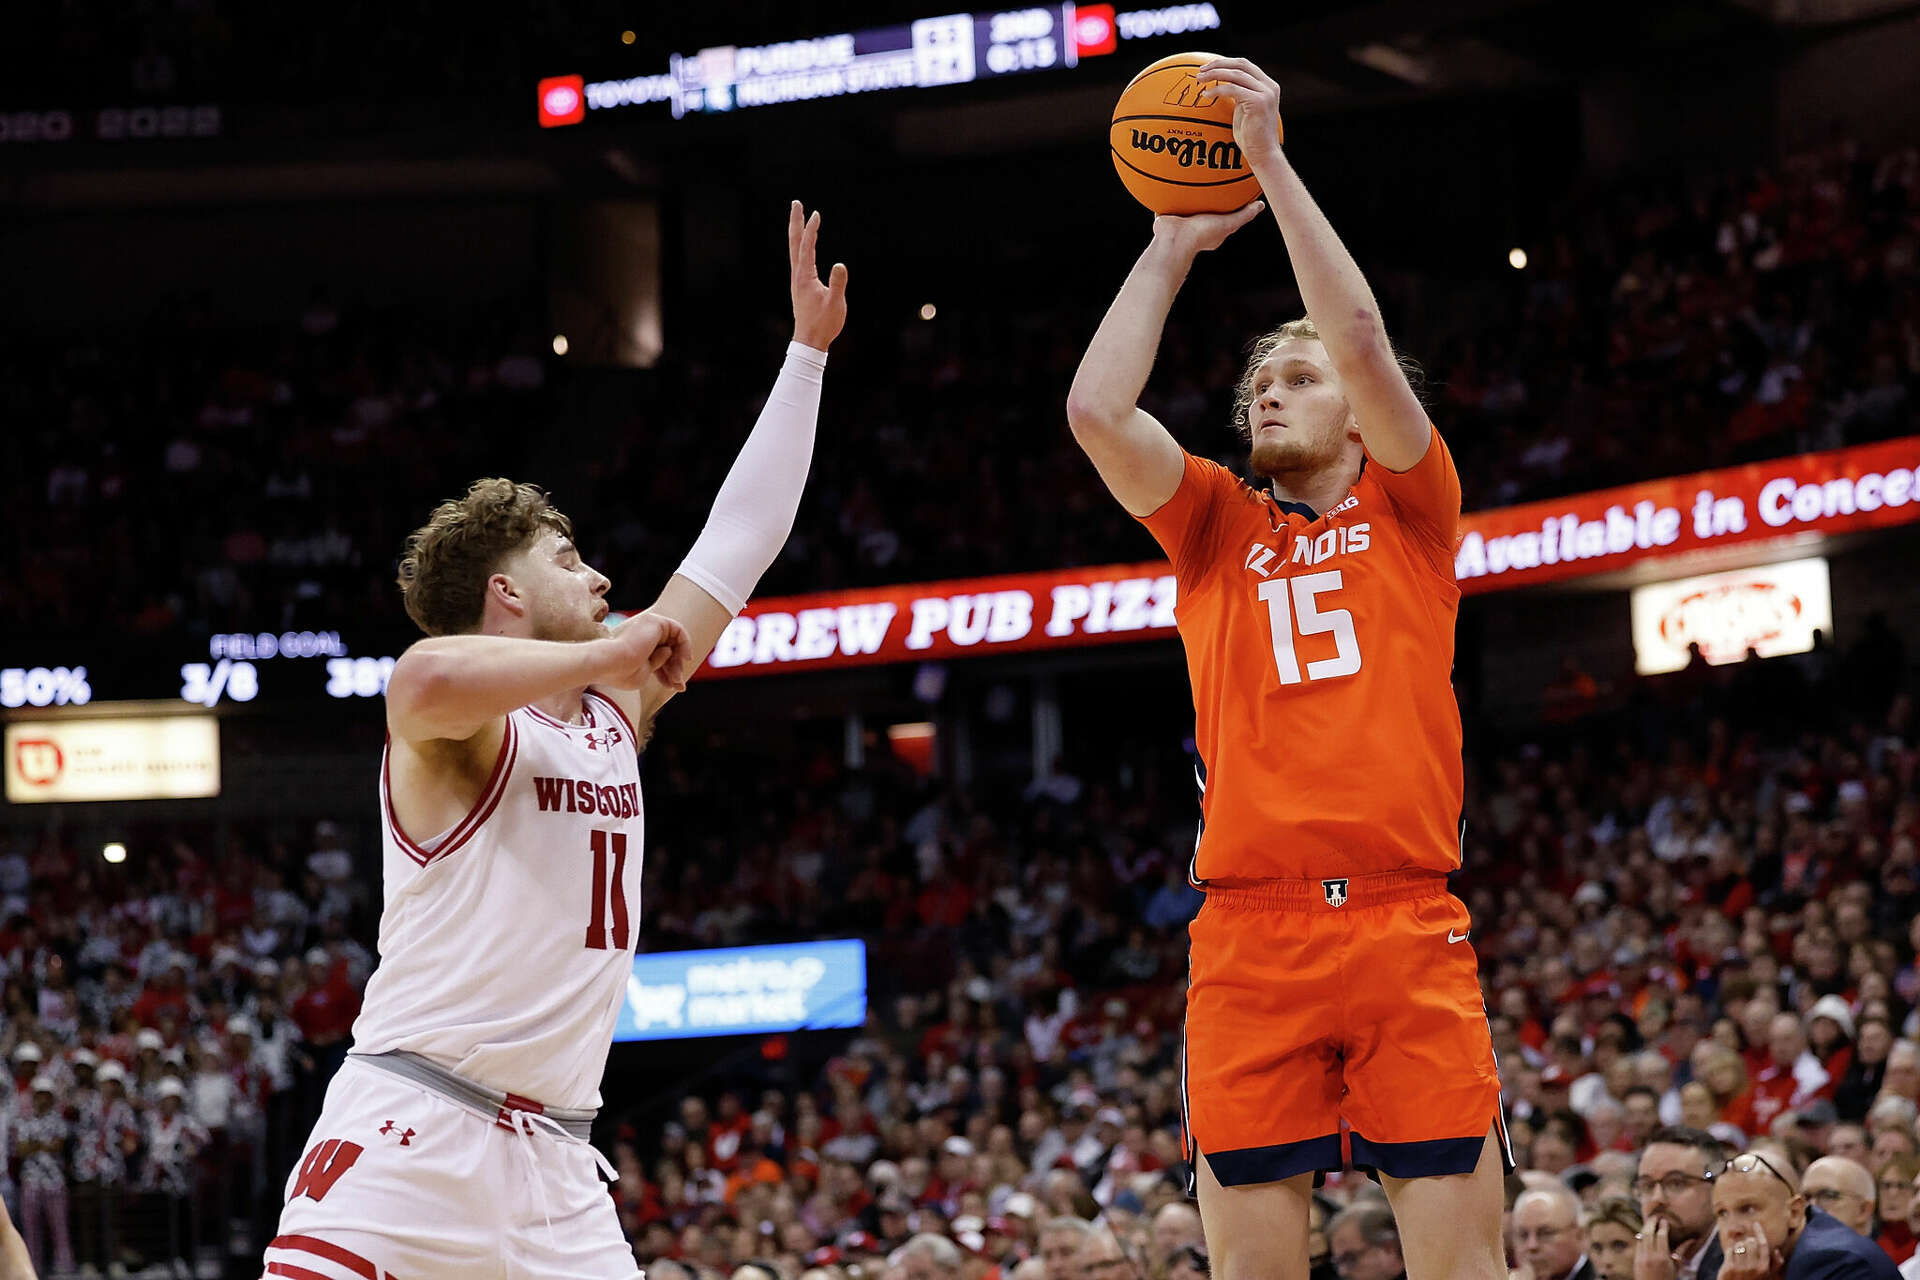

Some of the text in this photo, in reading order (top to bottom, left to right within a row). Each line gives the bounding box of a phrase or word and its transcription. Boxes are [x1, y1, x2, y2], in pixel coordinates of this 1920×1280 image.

[991, 9, 1053, 43] 2ND
[1116, 3, 1220, 38] TOYOTA
[735, 35, 854, 79] PURDUE
[584, 74, 674, 109] TOYOTA
[1130, 129, 1243, 170] Wilson
[1455, 466, 1920, 580] Available in Conce
[709, 601, 898, 667] BREW
[904, 589, 1034, 650] PUB
[1257, 569, 1362, 685] 15
[0, 665, 91, 708] 50%
[585, 829, 630, 951] 11
[687, 992, 808, 1028] market
[287, 1138, 365, 1202] W
